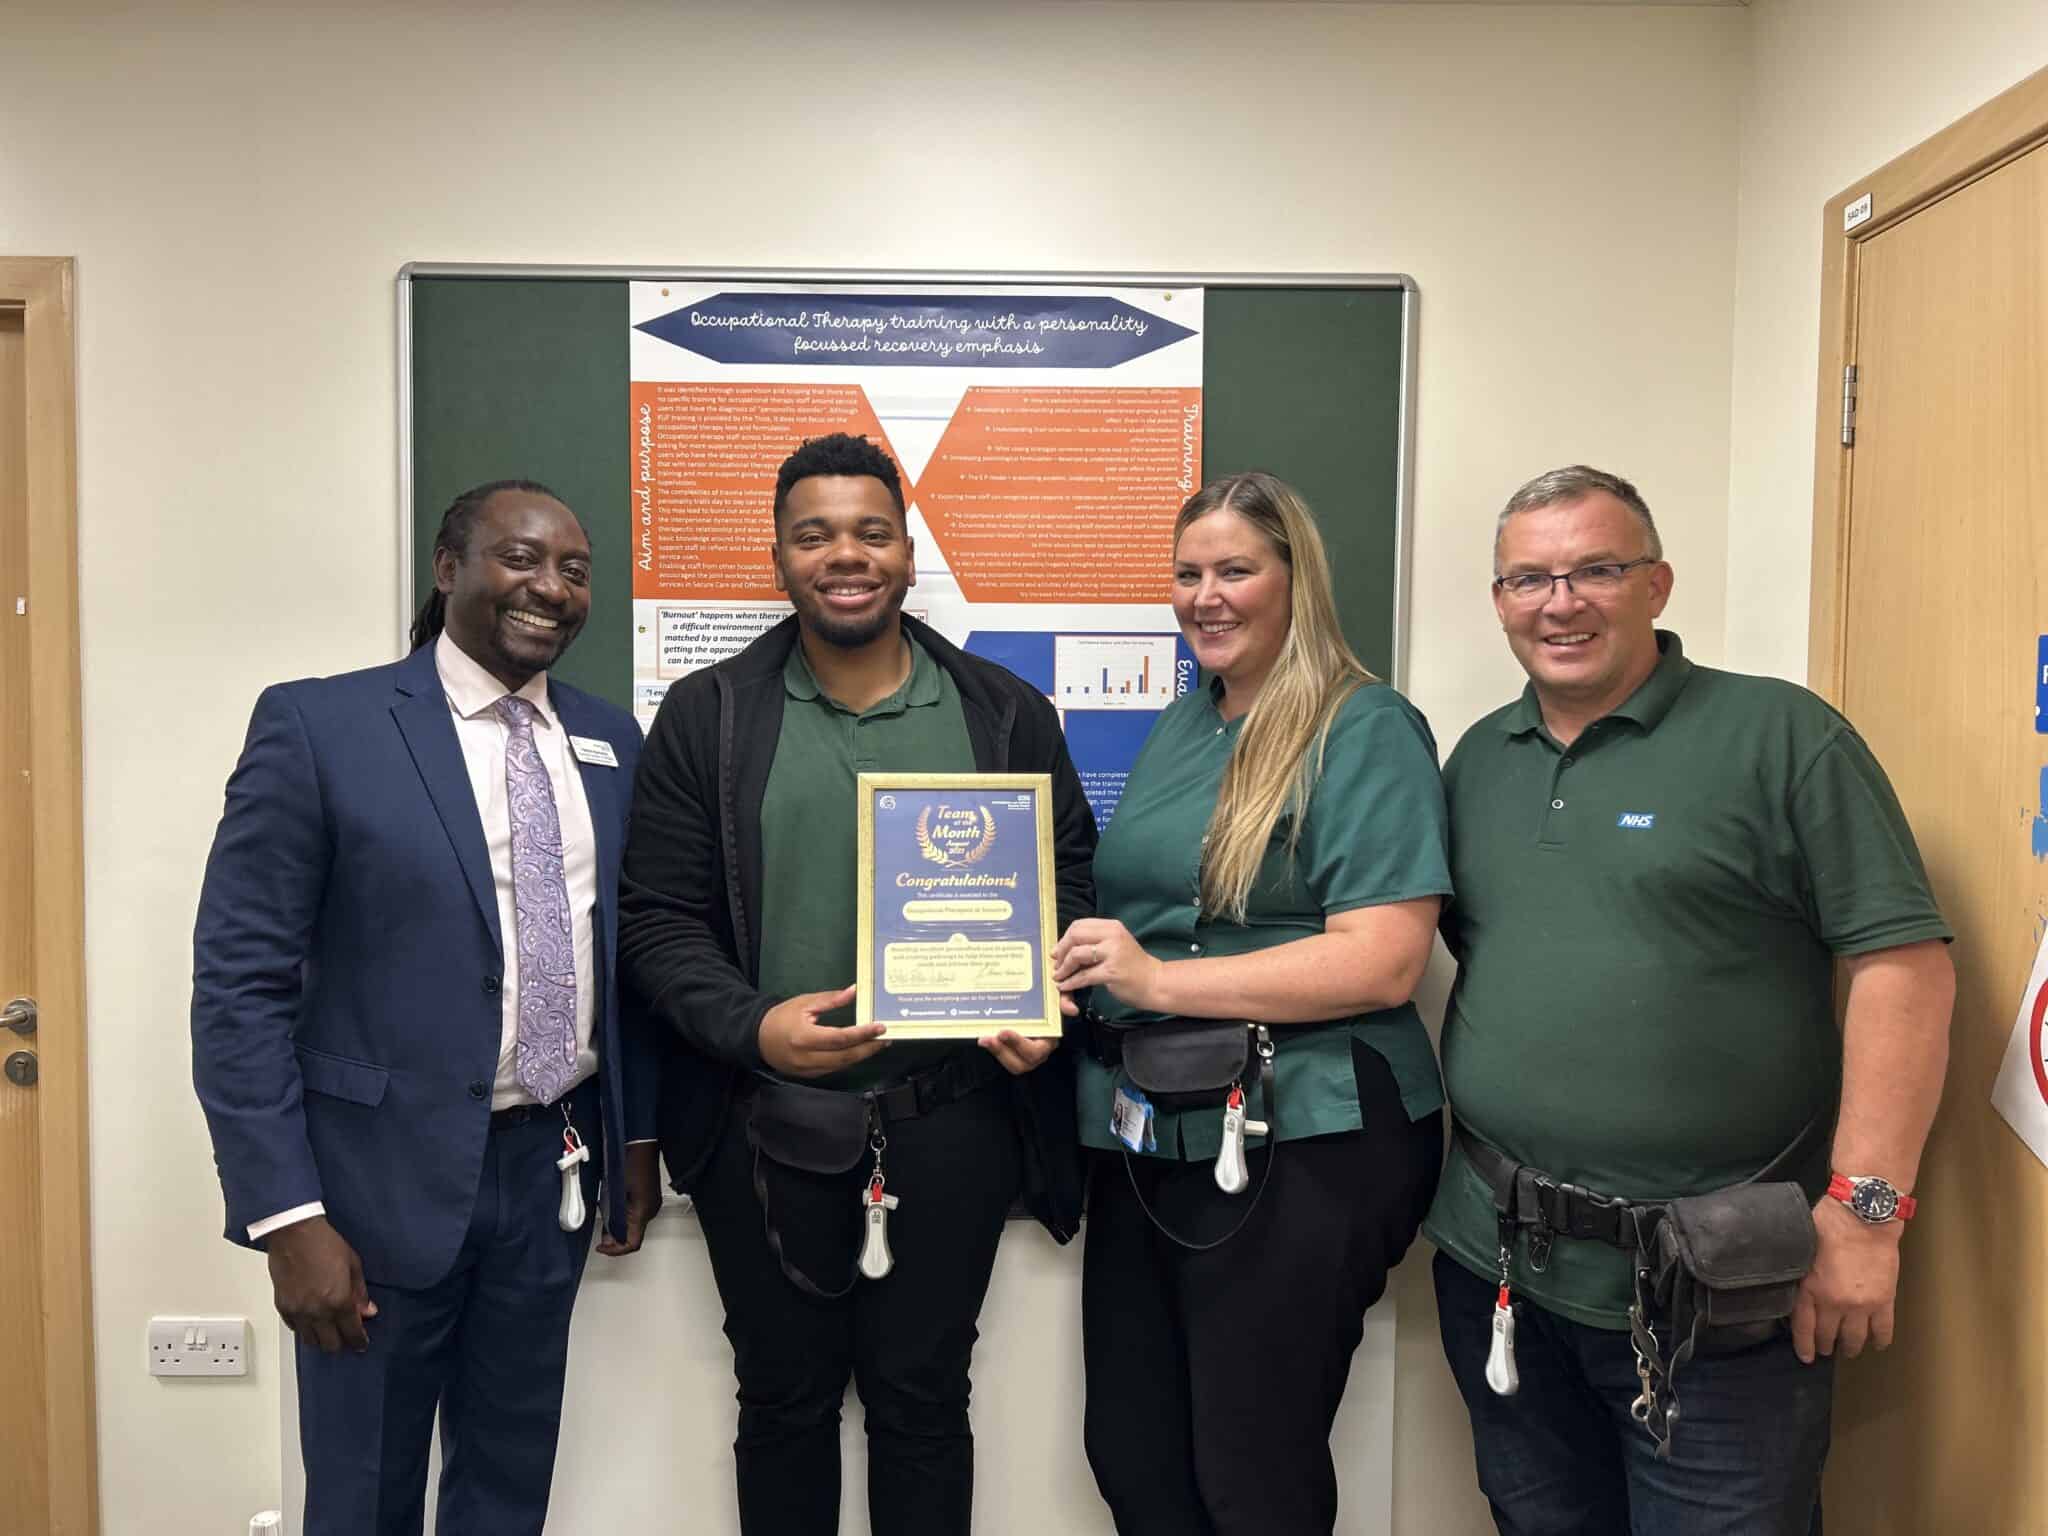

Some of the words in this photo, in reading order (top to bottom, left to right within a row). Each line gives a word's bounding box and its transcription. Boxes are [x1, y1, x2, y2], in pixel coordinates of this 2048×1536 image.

[691, 311, 810, 331] Occupational
[812, 312, 888, 334] Therapy
[890, 314, 971, 334] training
[975, 314, 1020, 331] with
[1022, 319, 1036, 330] a
[1039, 314, 1149, 336] personality
[794, 336, 871, 355] focussed
[874, 340, 952, 358] recovery
[956, 336, 1044, 358] emphasis
[638, 402, 656, 482] purpose
[1177, 403, 1198, 492] Training
[632, 486, 652, 526] and
[638, 528, 652, 572] Aim
[700, 611, 734, 620] happens
[760, 612, 780, 620] there
[680, 622, 711, 632] difficult
[664, 634, 700, 642] matched
[701, 634, 711, 643] by
[663, 645, 693, 654] getting
[709, 646, 745, 654] appropri
[938, 805, 976, 820] Team
[1618, 813, 1654, 827] NHS
[932, 824, 980, 839] Month
[896, 872, 1018, 890] Congratulations!
